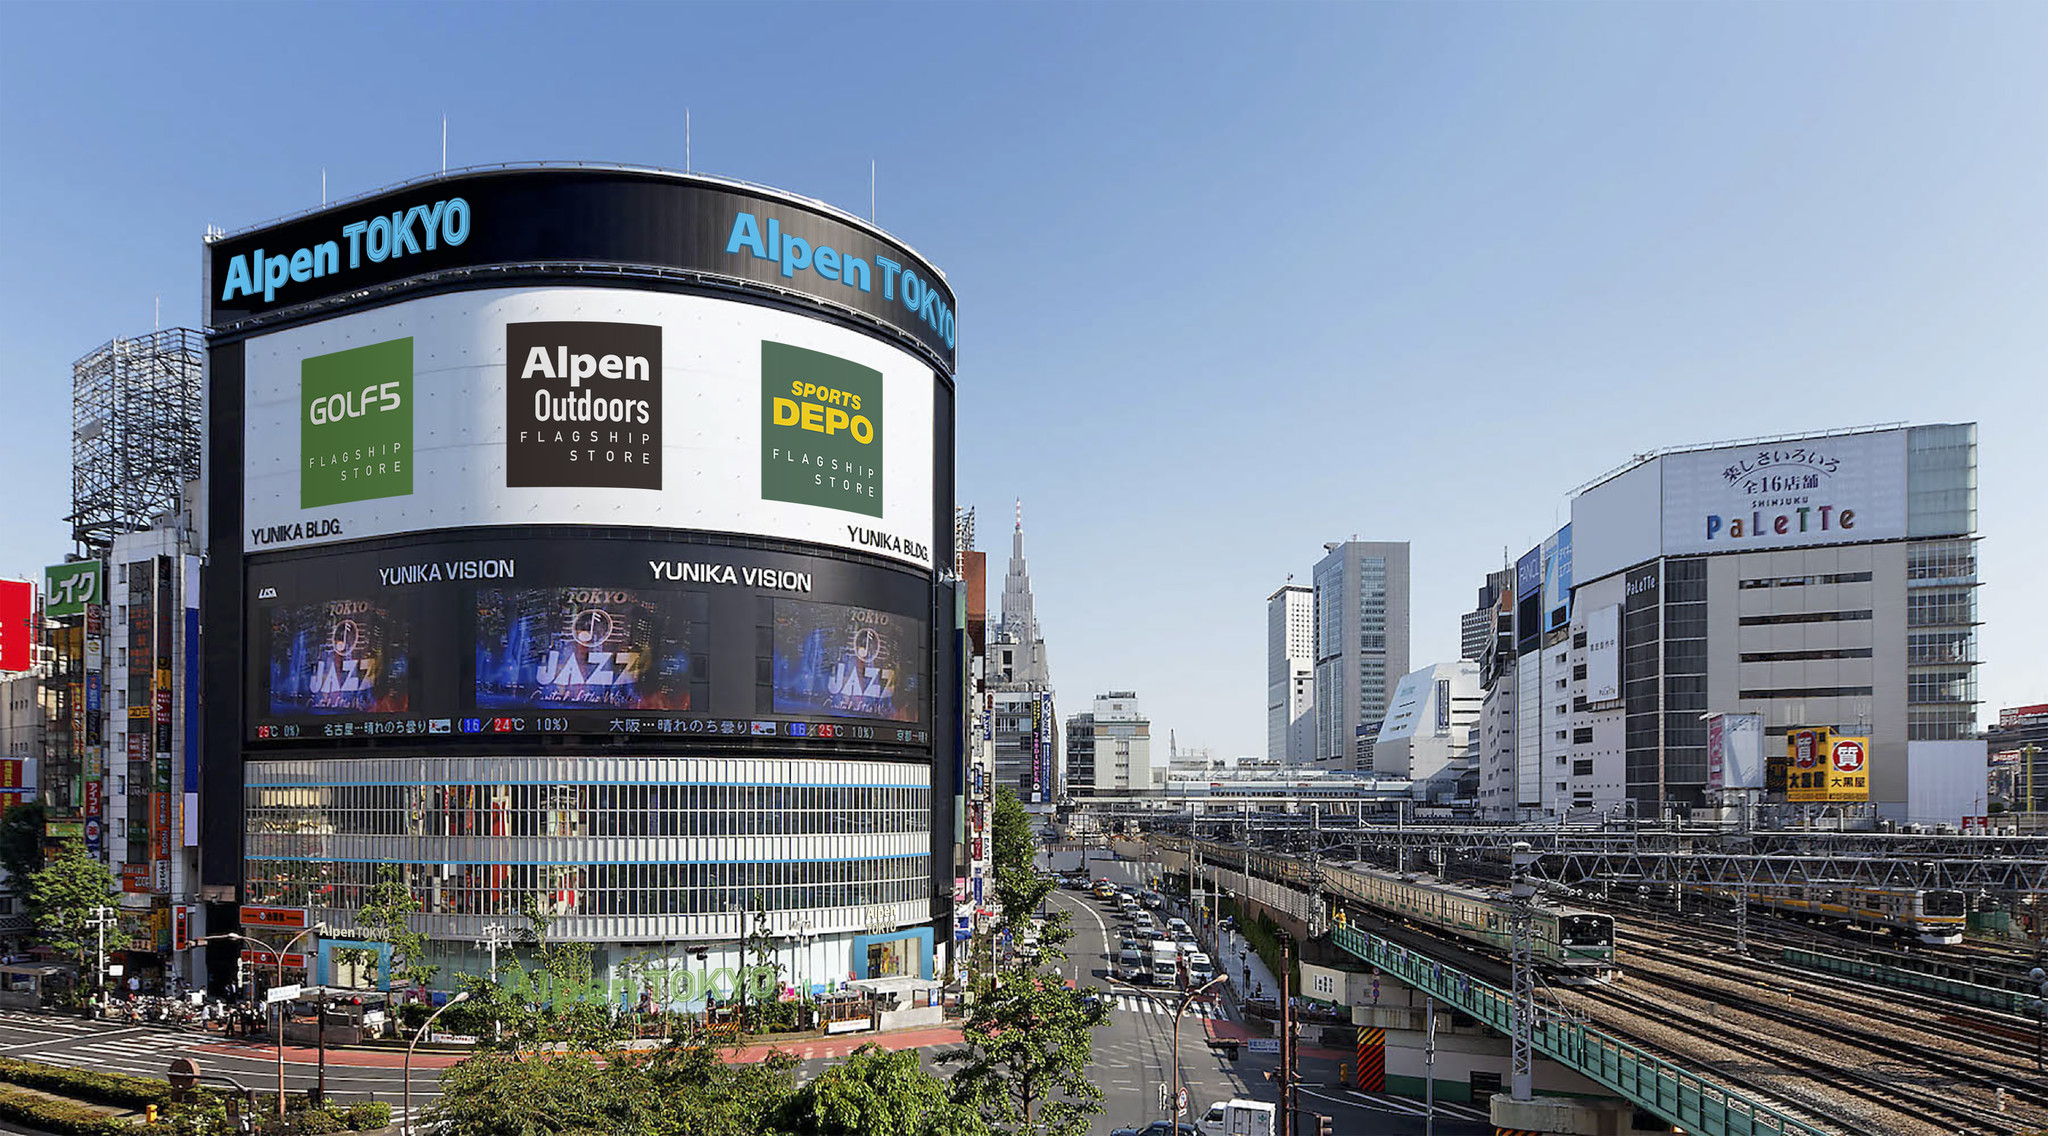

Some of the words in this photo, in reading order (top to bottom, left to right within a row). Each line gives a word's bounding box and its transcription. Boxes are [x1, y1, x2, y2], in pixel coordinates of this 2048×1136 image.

[222, 241, 339, 302] Alpen
[343, 197, 471, 269] TOKYO
[725, 212, 871, 293] Alpen
[875, 254, 955, 350] TOKYO
[521, 346, 650, 387] Alpen
[310, 381, 401, 425] GOLF5
[535, 389, 650, 424] Outdoors
[791, 380, 862, 411] SPORTS
[773, 396, 874, 445] DEPO
[520, 431, 650, 444] FLAGSHIP
[309, 443, 401, 468] FLAGSHIP
[570, 450, 650, 465] STORE
[773, 448, 874, 479] FLAGSHIP
[1723, 449, 1840, 482] 楽しさいろいろ
[341, 461, 401, 481] STORE
[1743, 474, 1819, 494] 全16店舗
[815, 474, 874, 498] STORE
[1752, 496, 1809, 508] SHINJUKU
[252, 523, 303, 545] YUNIKA
[306, 518, 343, 539] BLDG.
[847, 525, 901, 553] YUNIKA
[903, 539, 930, 562] BLDG.
[379, 563, 442, 586] YUNIKA
[445, 559, 515, 581] VISION
[649, 561, 738, 585] YUNIKA
[742, 567, 812, 592] VISION
[47, 571, 96, 606] レイク
[566, 591, 628, 604] TOKYO
[329, 600, 368, 615] TOKYO
[849, 608, 889, 625] TOKYO
[310, 659, 376, 693] JAZZ
[536, 650, 641, 684] JAZZ
[828, 662, 895, 698] JAZZ
[1838, 746, 1858, 767] 質
[1831, 776, 1865, 788] 大黒屋
[89, 782, 98, 813] アイフル
[866, 904, 897, 923] Alpen
[319, 924, 355, 940] Alpen
[356, 927, 390, 939] TOKYO
[866, 921, 897, 936] TOKYO
[643, 967, 777, 1002] TOKYO
